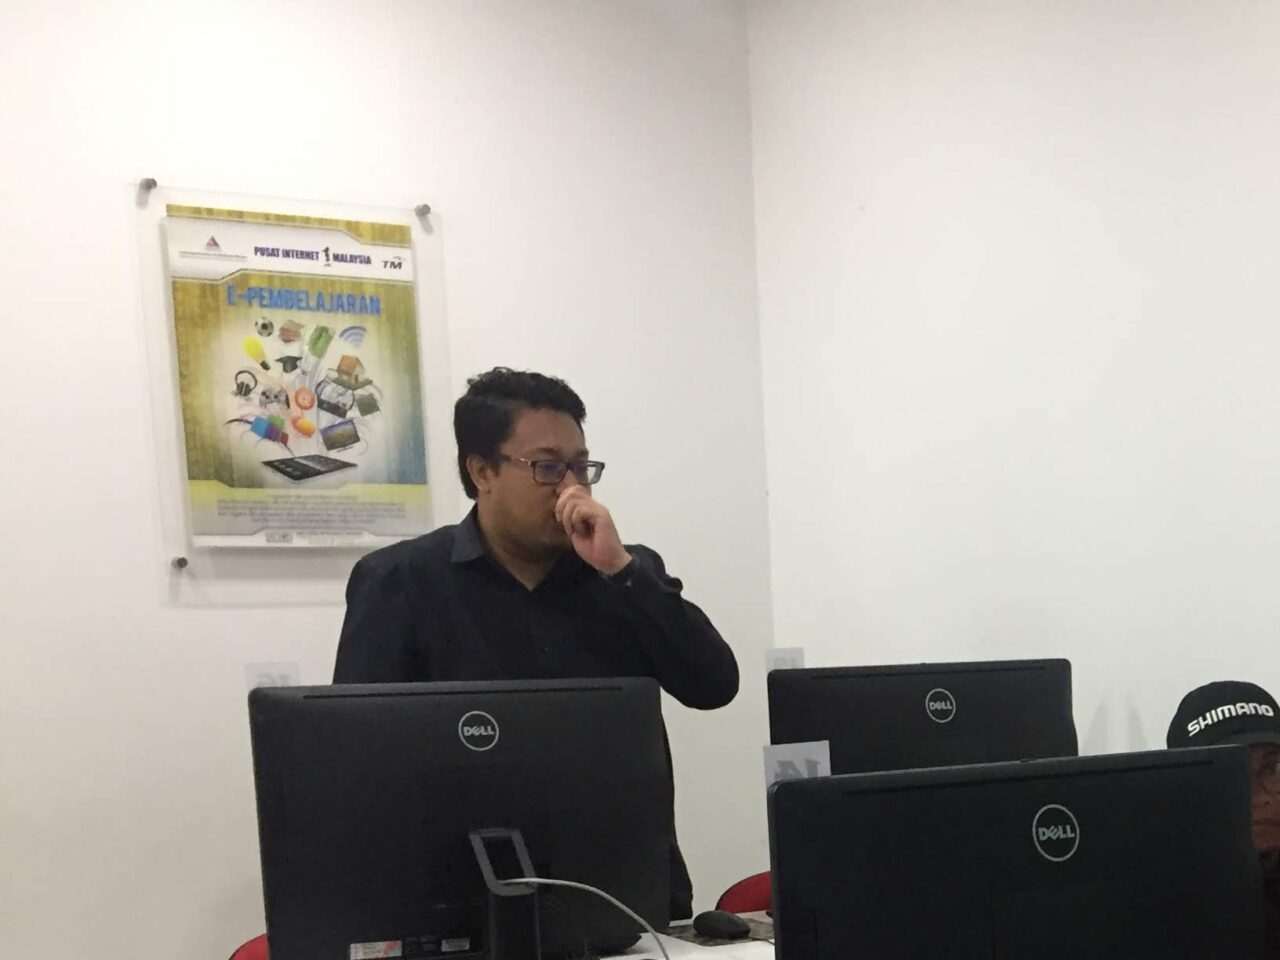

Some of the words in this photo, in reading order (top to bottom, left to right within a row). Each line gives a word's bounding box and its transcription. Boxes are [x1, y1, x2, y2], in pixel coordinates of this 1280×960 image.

[254, 246, 280, 258] PUSAT
[281, 249, 320, 261] INTERNET
[332, 253, 372, 265] MALAYSIA
[382, 260, 403, 270] TM
[1187, 702, 1275, 737] SHIMANO
[463, 725, 495, 737] DELL
[1038, 824, 1075, 841] DELL
